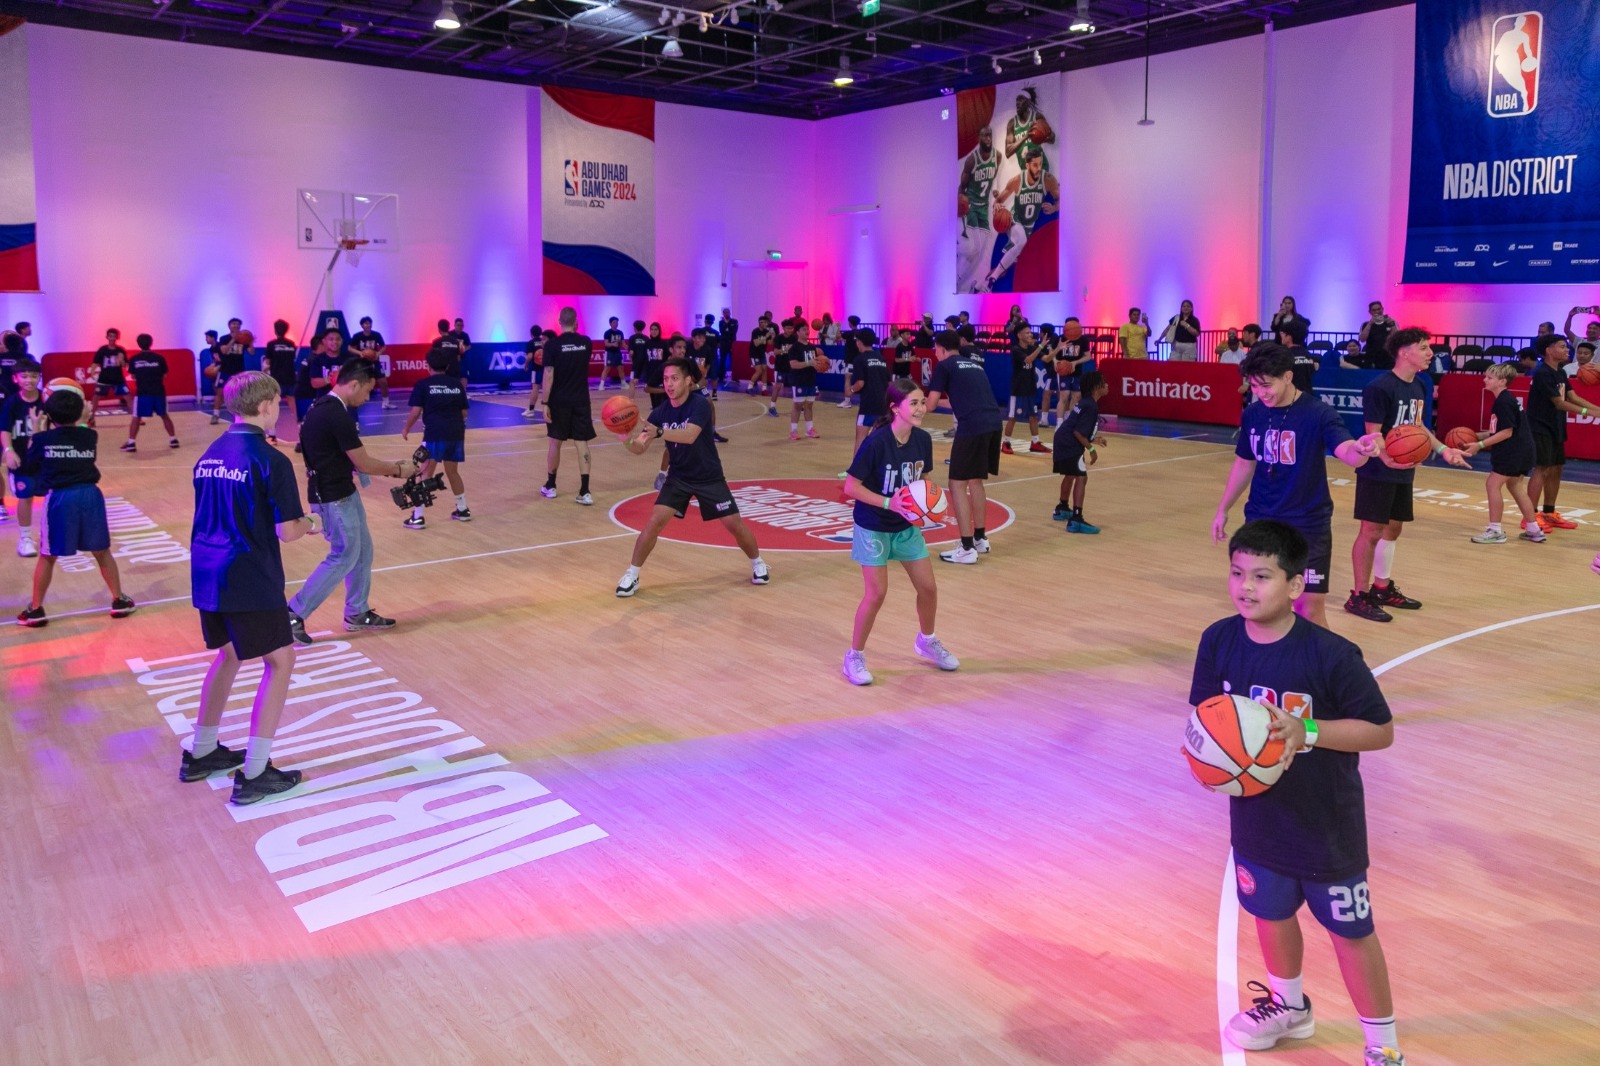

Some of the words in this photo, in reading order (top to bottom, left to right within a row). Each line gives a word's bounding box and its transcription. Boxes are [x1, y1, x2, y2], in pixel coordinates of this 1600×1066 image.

[1495, 93, 1518, 111] NBA
[581, 160, 600, 180] ABU
[601, 162, 628, 182] DHABI
[1443, 162, 1489, 200] NBA
[1491, 154, 1578, 198] DISTRICT
[581, 179, 612, 199] GAMES
[613, 181, 637, 201] 2024
[980, 181, 989, 197] 7
[1020, 191, 1043, 205] BOSTON
[1025, 204, 1036, 219] 0
[1122, 376, 1212, 402] Emirates
[1320, 394, 1364, 408] NIN
[213, 466, 249, 482] dhabi
[225, 736, 610, 934] NBA
[1328, 880, 1370, 922] 28
